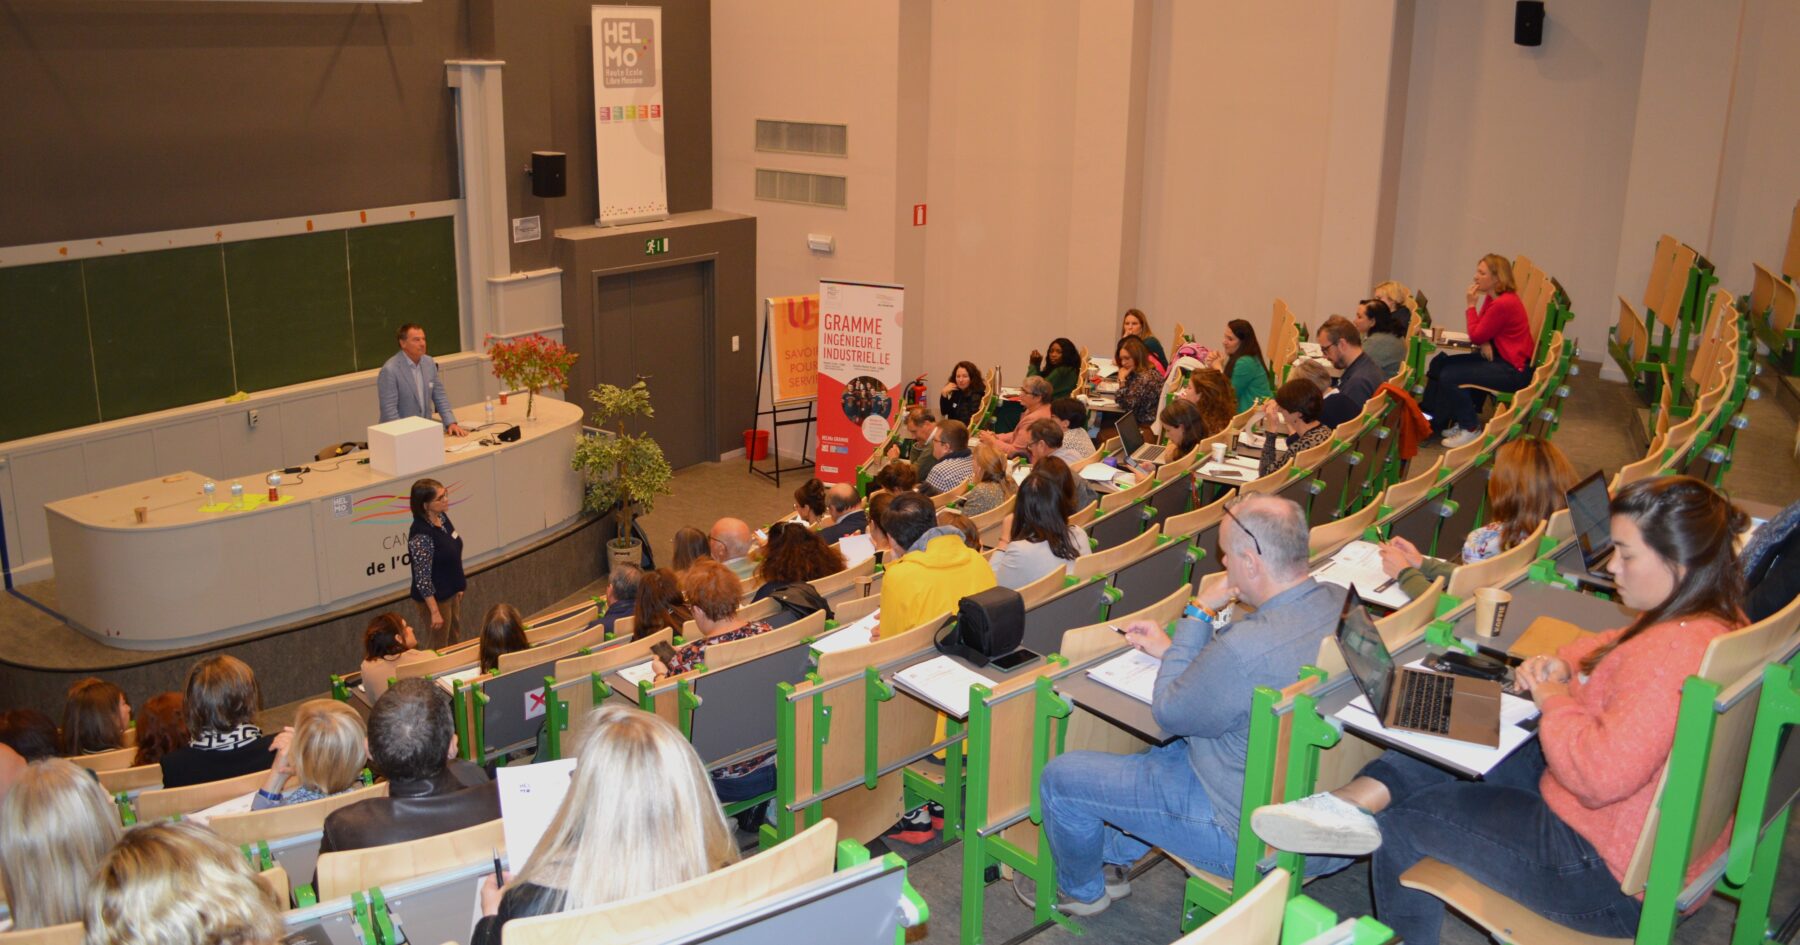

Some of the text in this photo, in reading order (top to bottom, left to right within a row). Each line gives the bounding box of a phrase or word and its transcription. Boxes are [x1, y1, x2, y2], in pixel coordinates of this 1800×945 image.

[604, 22, 641, 44] HEL
[605, 46, 638, 68] MO
[824, 313, 883, 335] GRAMME
[366, 562, 386, 576] de
